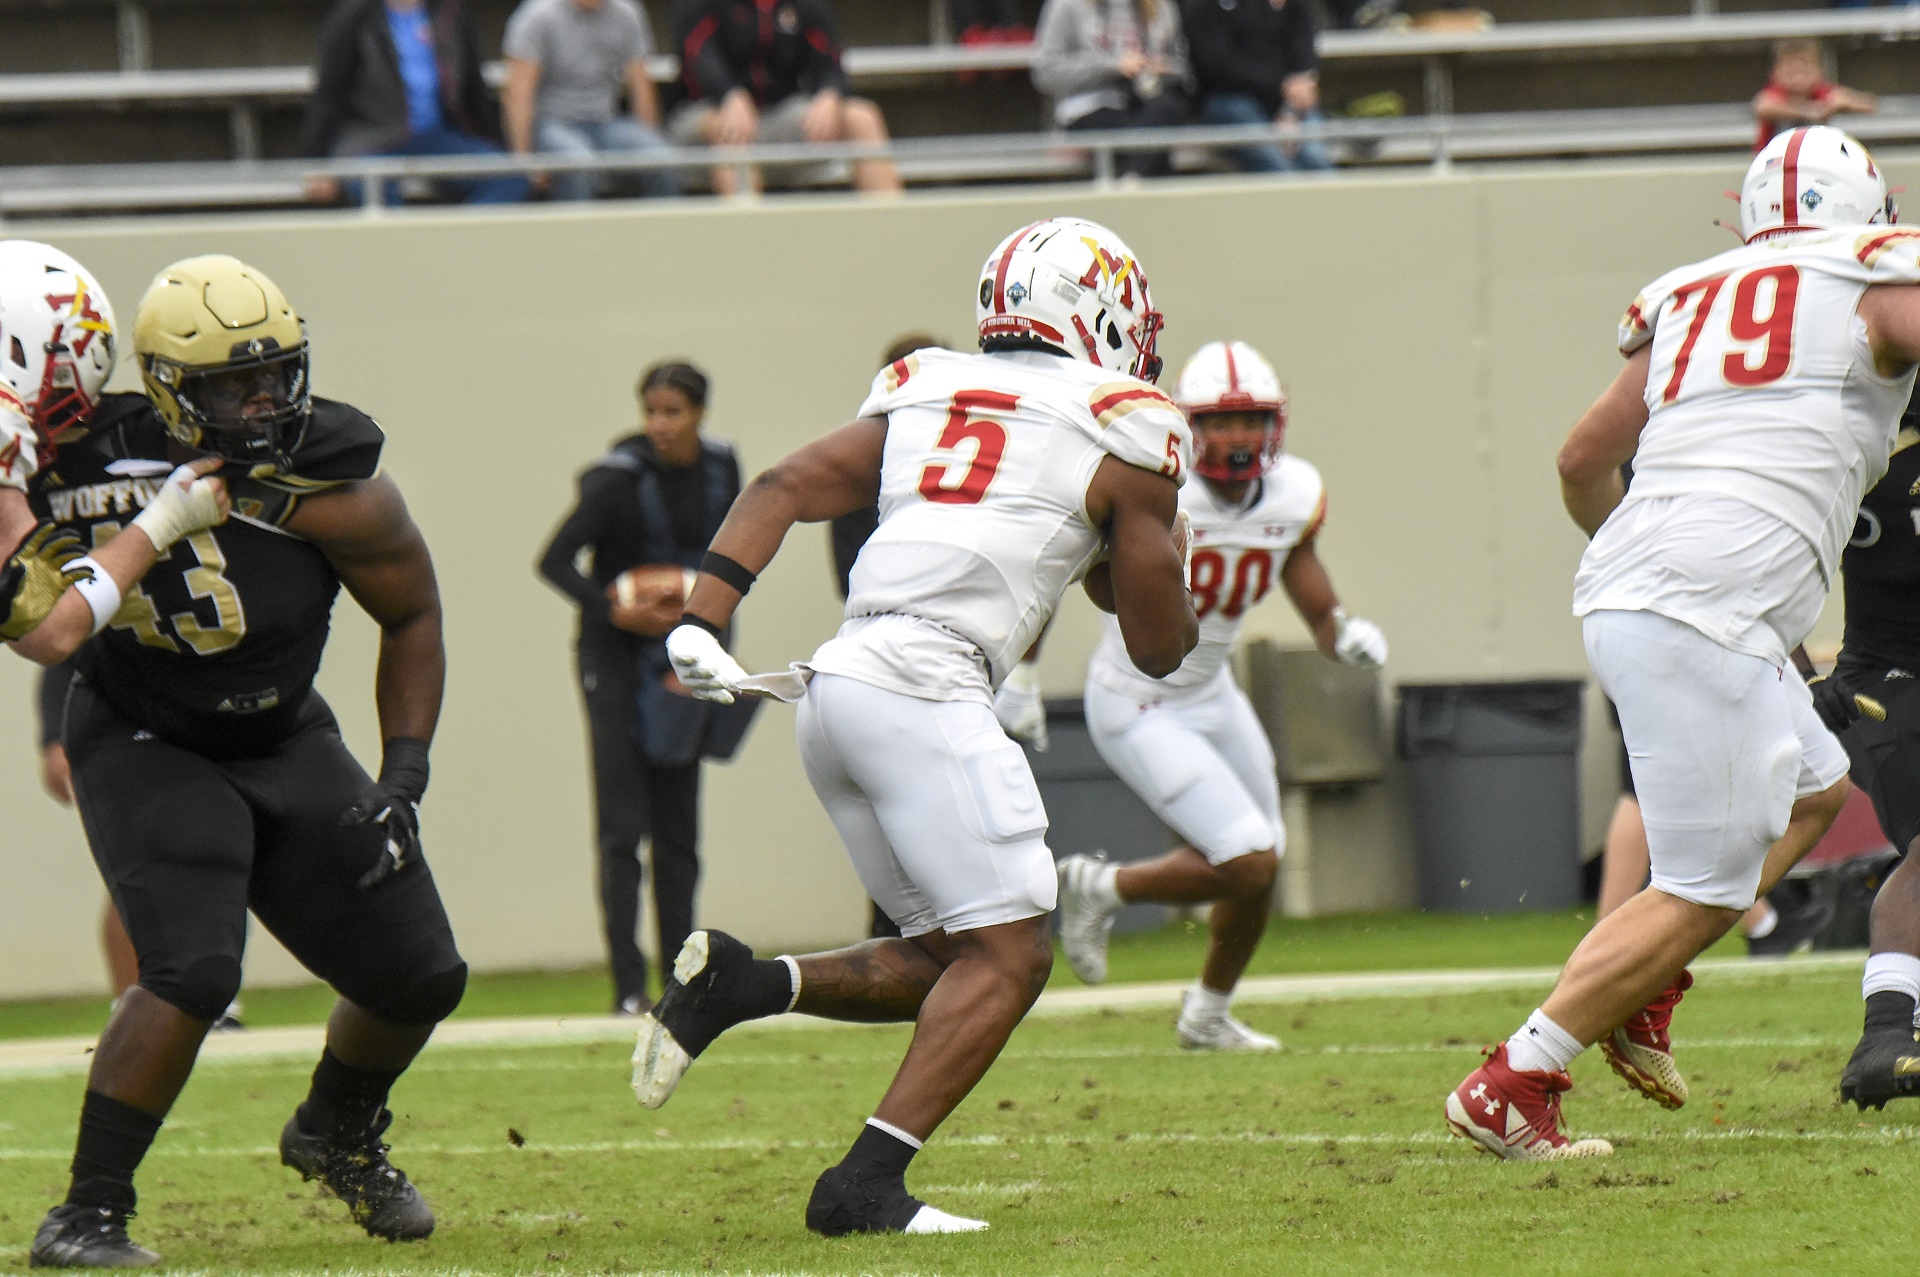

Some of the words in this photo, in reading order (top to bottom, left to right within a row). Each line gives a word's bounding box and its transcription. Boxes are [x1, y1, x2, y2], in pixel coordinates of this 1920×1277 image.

[1769, 203, 1781, 213] 79
[1661, 264, 1801, 406] 79
[915, 388, 1023, 505] 5
[1159, 429, 1182, 479] 5
[1190, 548, 1274, 622] 80
